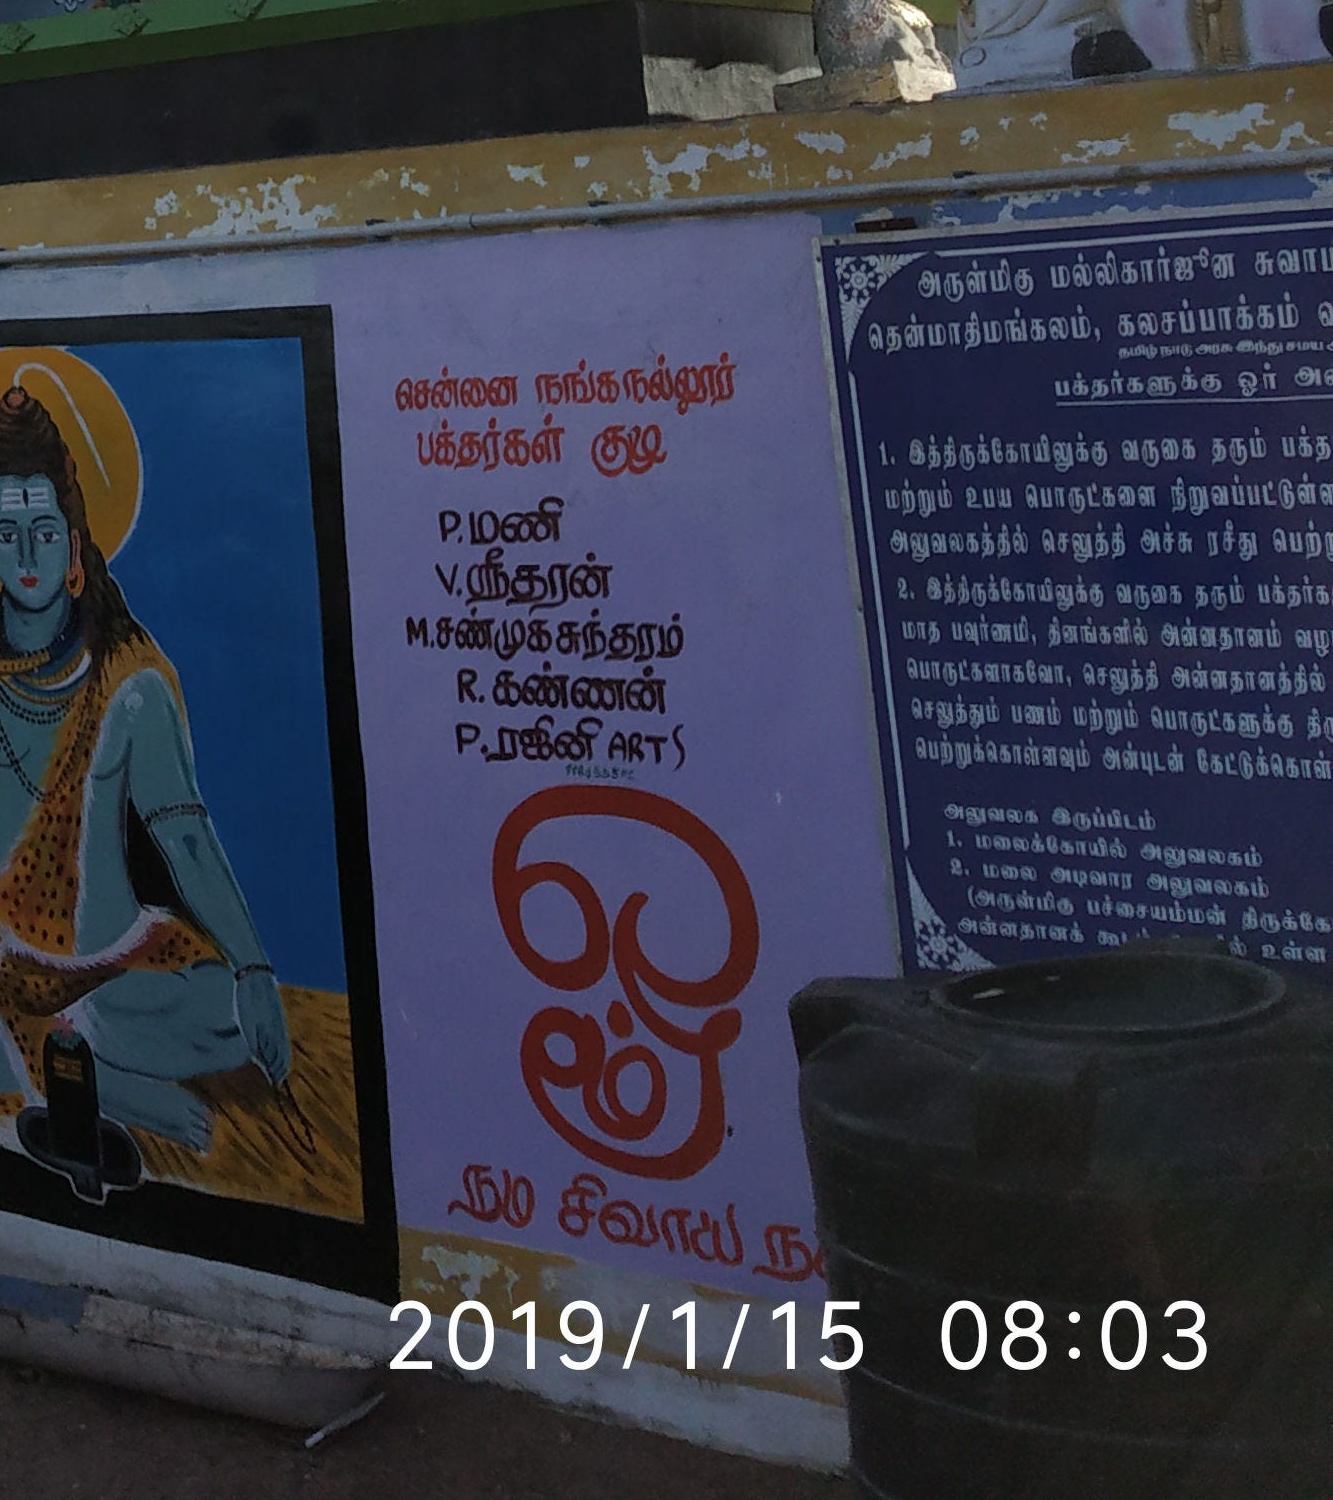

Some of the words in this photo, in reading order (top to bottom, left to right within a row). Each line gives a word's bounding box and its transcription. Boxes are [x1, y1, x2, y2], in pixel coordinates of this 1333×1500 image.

[918, 259, 1033, 302] அருள்மிகு
[1051, 246, 1234, 288] மல்லிகார்ஜுன
[869, 305, 1100, 354] தென்மாதிமங்கலம்,
[1118, 292, 1298, 336] கலசப்பாக்கம்
[395, 367, 518, 411] சென்னை
[1055, 370, 1222, 399] பக்தர்களுக்கு
[1238, 363, 1276, 396] ஓர்
[417, 413, 565, 471] பக்தர்கள்
[879, 442, 895, 465] 1.
[909, 432, 1107, 472] இத்திருக்கோயிலுக்கு
[1122, 438, 1195, 467] வருகை
[1212, 427, 1266, 465] தரும்
[885, 479, 952, 517] மற்றும்
[966, 487, 1012, 508] உபய
[1025, 483, 1155, 514] பொருட்களை
[890, 522, 1028, 562] அலுவலகத்தில்
[1042, 522, 1125, 563] செலுத்தி
[1140, 522, 1192, 553] அச்சு
[1208, 520, 1258, 561] ரசீது
[898, 578, 914, 599] 2.
[927, 573, 1103, 611] இத்திருக்கோயிலுக்கு
[1116, 584, 1182, 610] வருகை
[1196, 575, 1244, 610] தரும்
[902, 622, 940, 644] மாத
[1049, 617, 1148, 647] தினங்களில்
[1161, 617, 1282, 652] அன்னதானம்
[1083, 659, 1158, 695] செலுத்தி
[1172, 661, 1325, 696] அன்னதானத்தில்
[912, 694, 1000, 729] செலுத்தும்
[1011, 697, 1061, 725] பணம்
[1073, 699, 1138, 735] மற்றும்
[1151, 704, 1293, 738] பொருட்களுக்கு
[608, 725, 685, 770] ARTS
[916, 733, 1090, 772] பெற்றுக்கொள்ளவும்
[1103, 741, 1183, 776] அன்புடன்
[944, 804, 1038, 826] அலுவலக
[1052, 807, 1155, 831] இருப்பிடம்
[947, 830, 962, 847] 1.
[975, 832, 1126, 858] மலைக்கோயில்
[1141, 843, 1262, 868] அலுவலகம்
[951, 858, 969, 876] 2.
[983, 864, 1037, 881] மலை
[1051, 867, 1131, 889] அடிவார
[1147, 874, 1269, 898] அலுவலகம்
[968, 886, 1074, 915] (அருள்மிகு
[1088, 895, 1226, 925] பச்சையம்மன்
[957, 915, 1085, 946] அன்னதானக்
